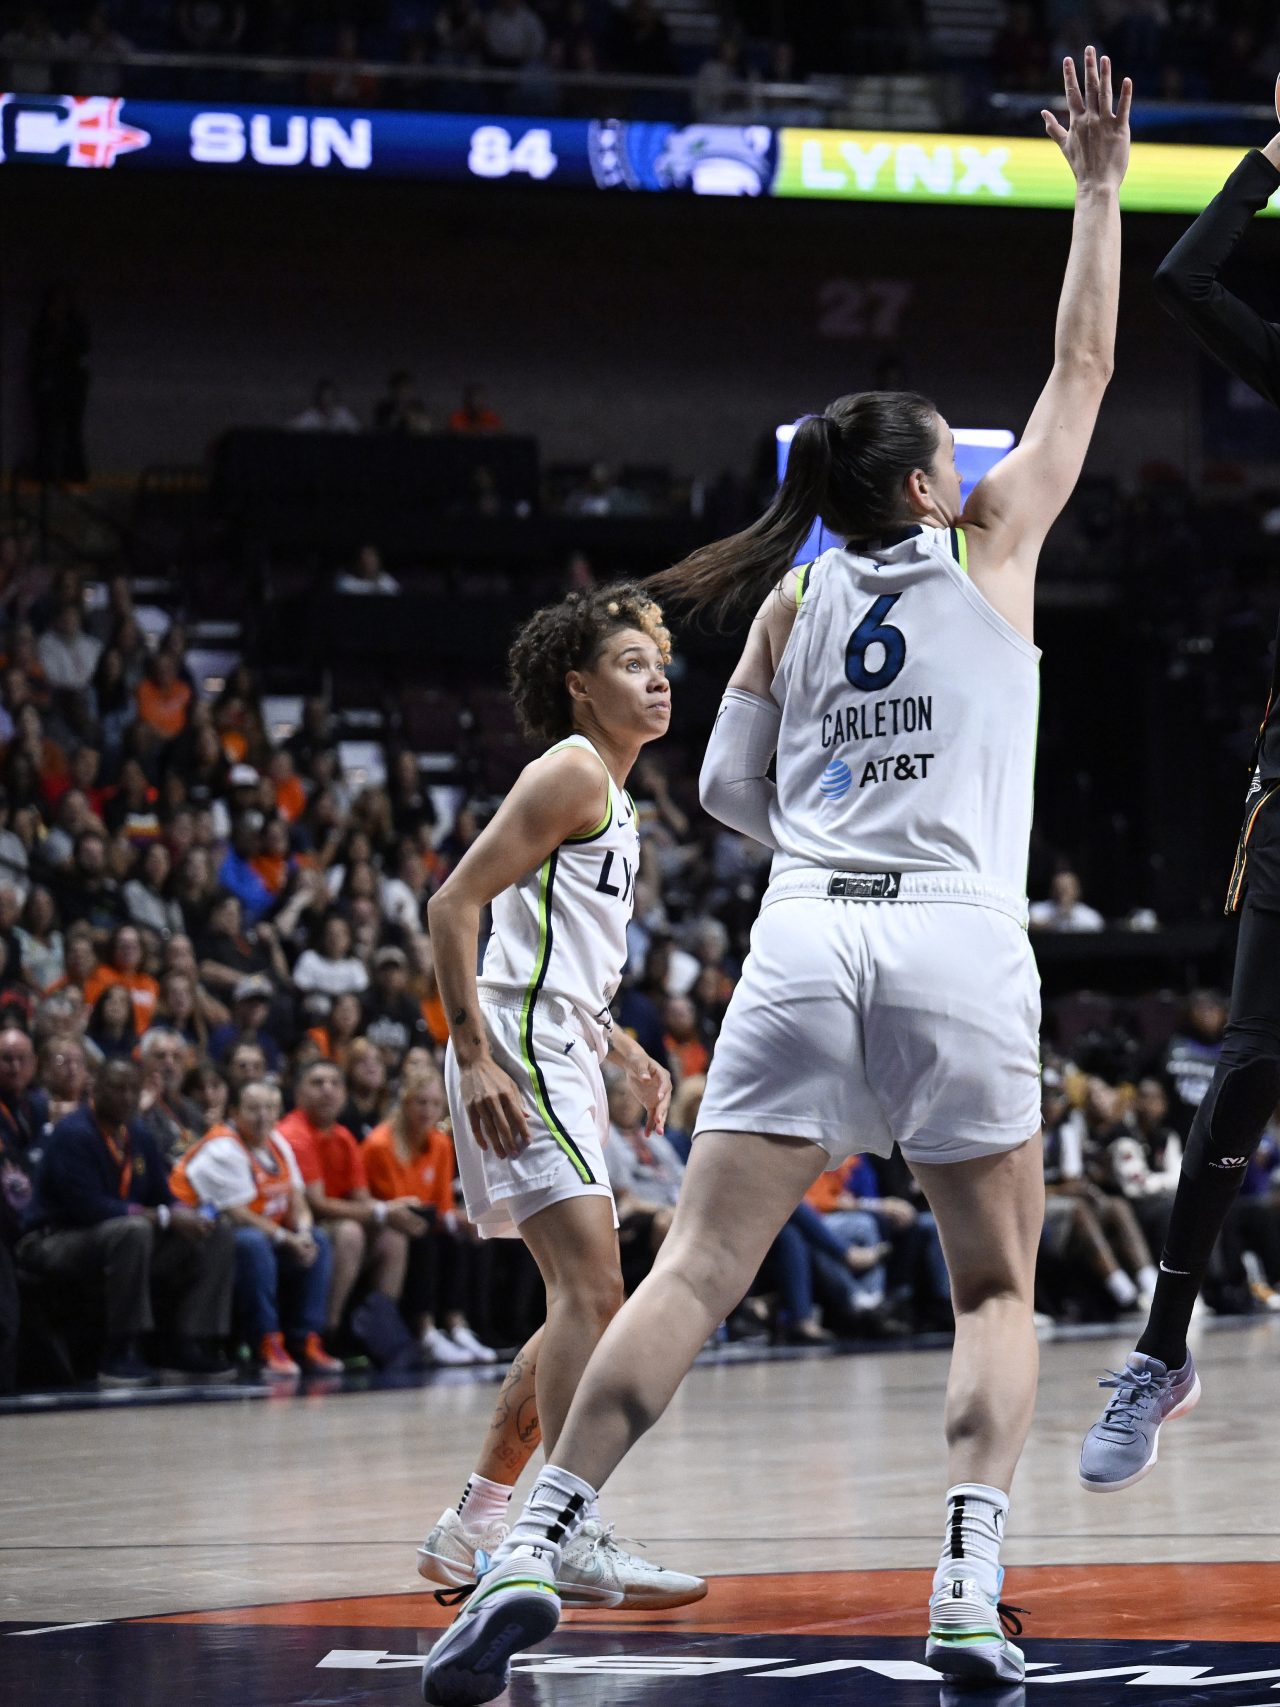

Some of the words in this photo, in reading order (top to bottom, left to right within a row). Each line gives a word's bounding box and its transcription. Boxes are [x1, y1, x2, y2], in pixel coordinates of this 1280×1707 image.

[190, 112, 372, 169] SUN
[468, 125, 557, 180] 84
[798, 138, 1015, 197] LYNX
[817, 278, 914, 339] 27
[845, 591, 906, 691] 6
[821, 696, 932, 748] CARLETON
[859, 754, 934, 787] AT&T
